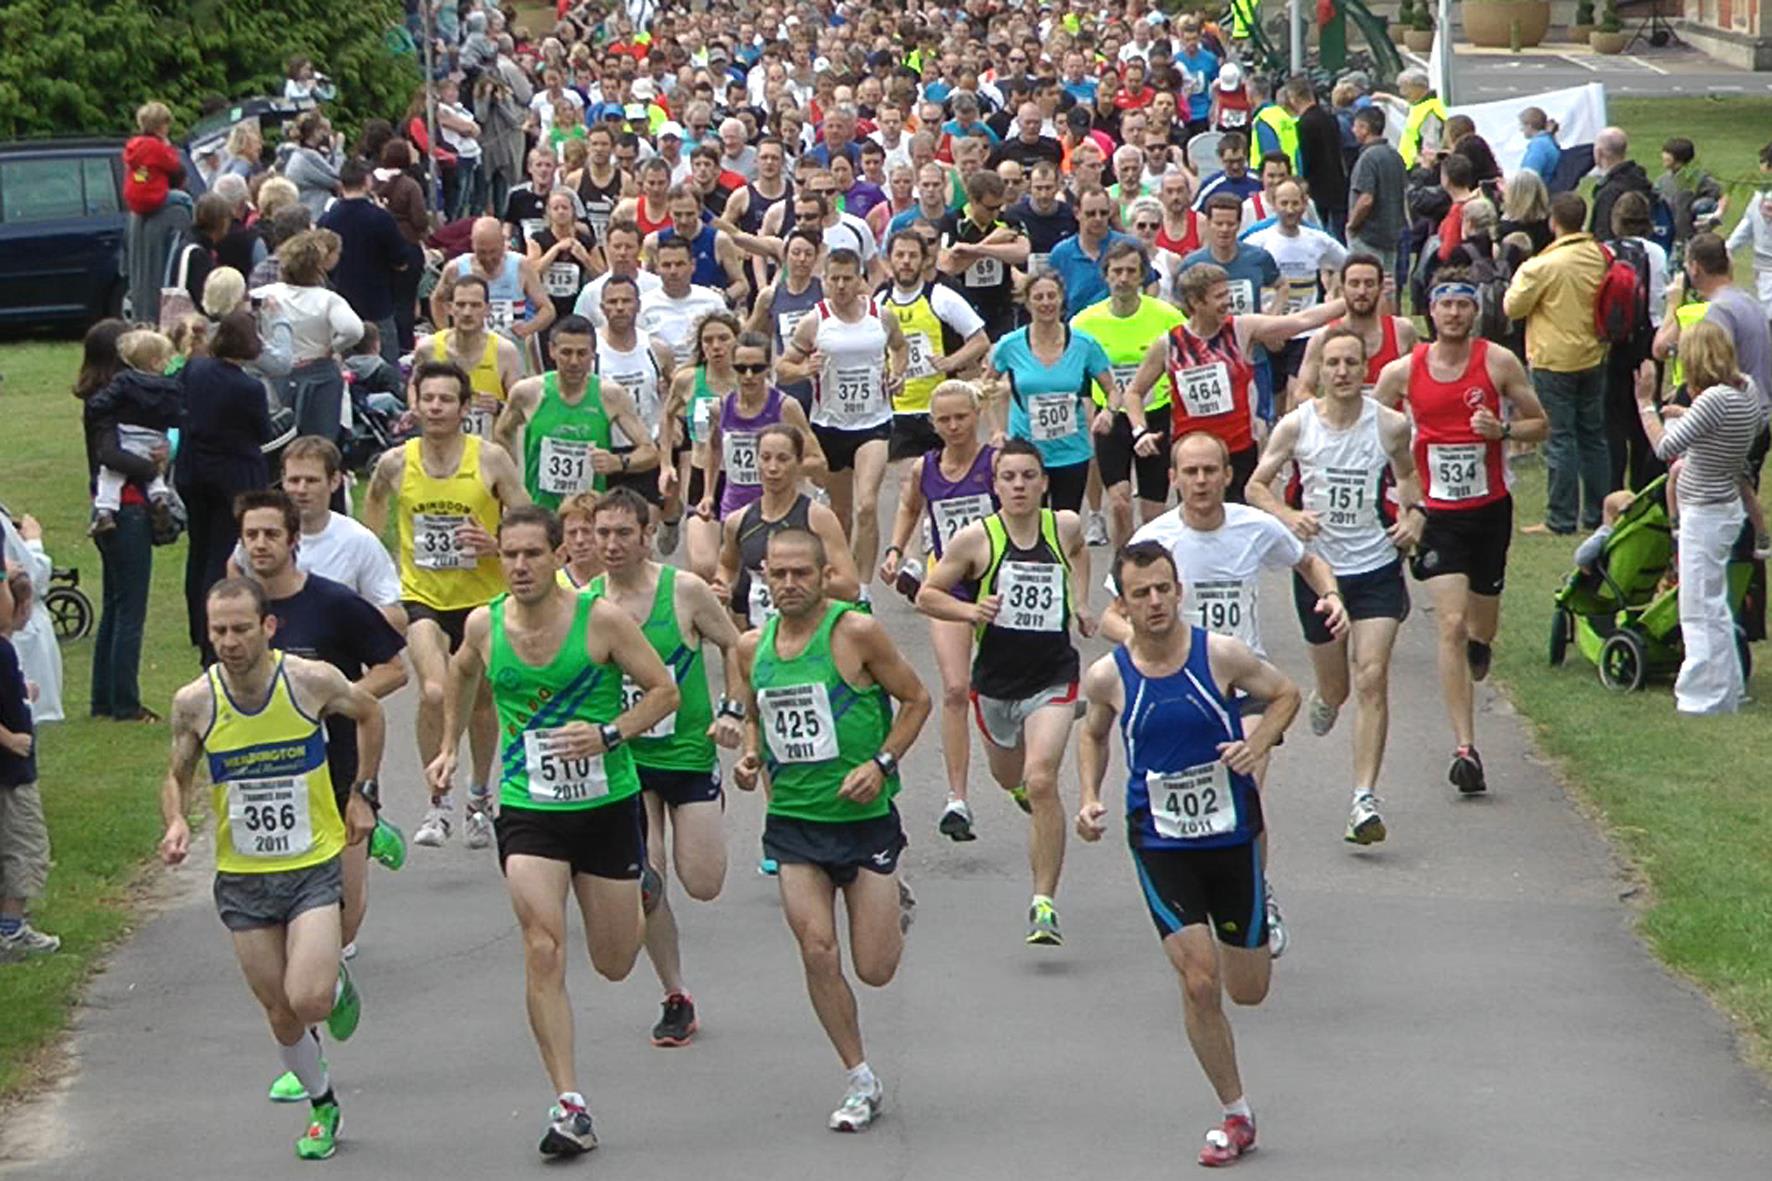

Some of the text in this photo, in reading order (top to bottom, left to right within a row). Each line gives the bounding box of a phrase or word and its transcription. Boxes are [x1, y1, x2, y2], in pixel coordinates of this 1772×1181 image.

[838, 383, 871, 400] 375
[1189, 380, 1222, 402] 464
[463, 417, 483, 433] 01
[1038, 405, 1069, 426] 500
[548, 456, 585, 478] 331
[733, 449, 755, 468] 42
[1440, 462, 1476, 483] 534
[1329, 486, 1364, 509] 151
[1330, 511, 1357, 524] 2011
[425, 532, 462, 552] 33
[1009, 584, 1053, 610] 383
[1014, 612, 1045, 627] 2011
[1198, 602, 1241, 628] 190
[775, 709, 820, 738] 425
[785, 742, 815, 759] 2011
[541, 754, 590, 781] 510
[553, 783, 587, 800] 2011
[1166, 788, 1219, 817] 402
[244, 804, 296, 831] 366
[1178, 820, 1214, 834] 2011
[255, 835, 289, 852] 2011
